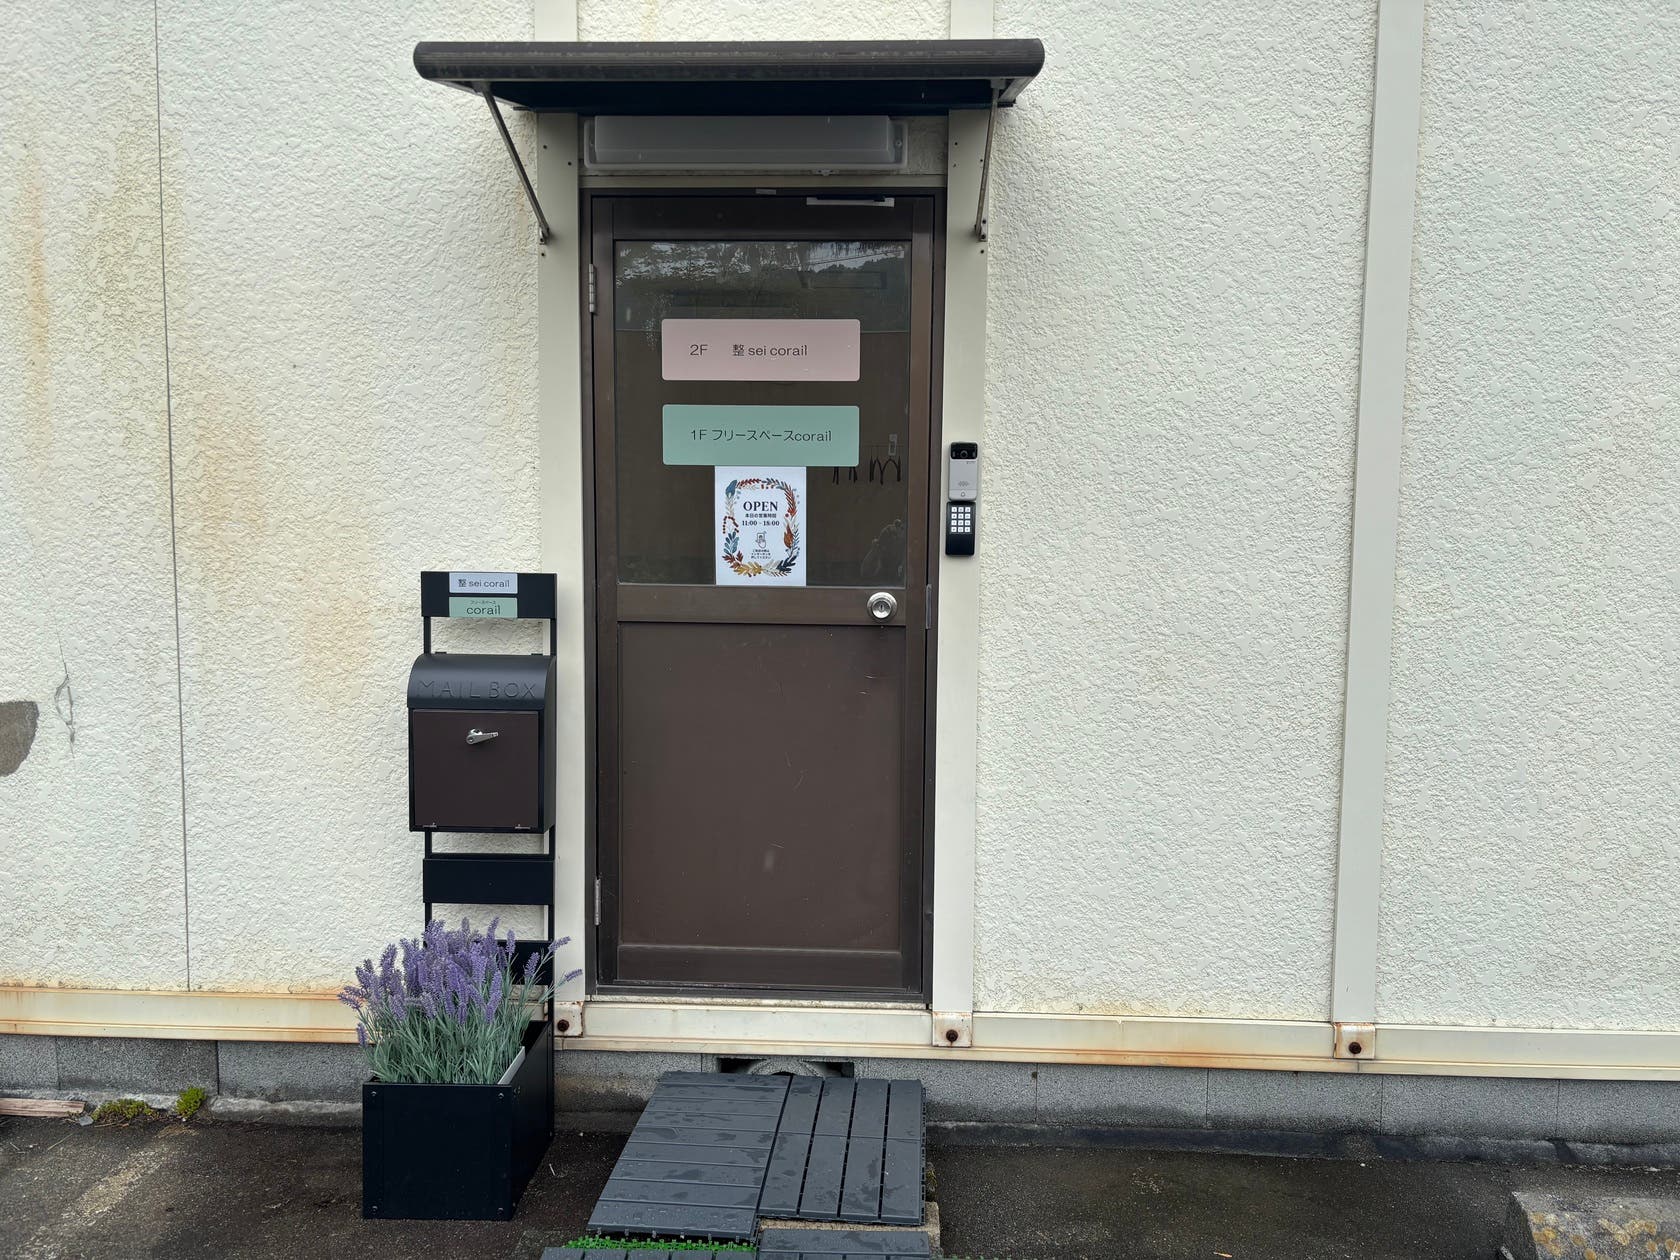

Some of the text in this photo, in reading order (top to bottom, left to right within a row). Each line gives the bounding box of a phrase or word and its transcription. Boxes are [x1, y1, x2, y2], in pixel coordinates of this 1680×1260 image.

[689, 344, 808, 357] 2F 整 sei corail
[691, 429, 708, 441] 1F
[743, 501, 778, 512] OPEN
[468, 579, 482, 588] sei
[483, 579, 510, 588] corail
[466, 605, 501, 615] corail
[418, 680, 537, 699] MAIL BOX
